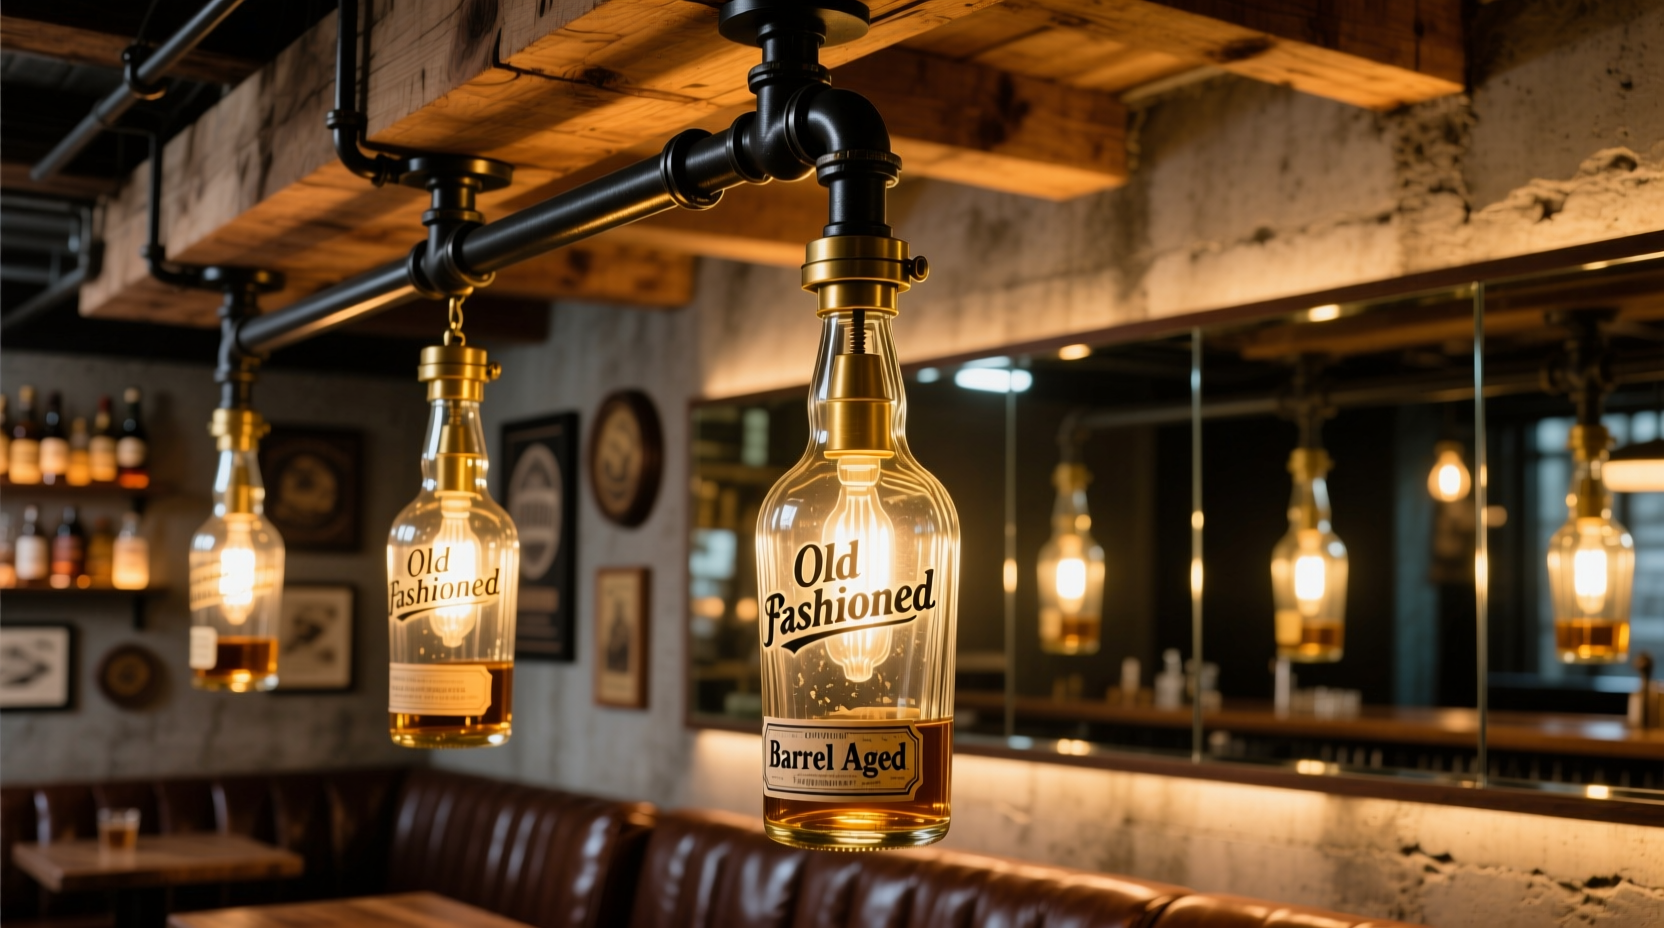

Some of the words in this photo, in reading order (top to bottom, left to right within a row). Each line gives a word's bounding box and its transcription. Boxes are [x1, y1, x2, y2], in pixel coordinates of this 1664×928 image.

[407, 546, 450, 577] Old
[794, 539, 861, 588] Old
[389, 567, 500, 616] Fashioned
[763, 568, 936, 647] Fashioned
[769, 739, 834, 771] Barrel
[841, 741, 907, 778] Aged
